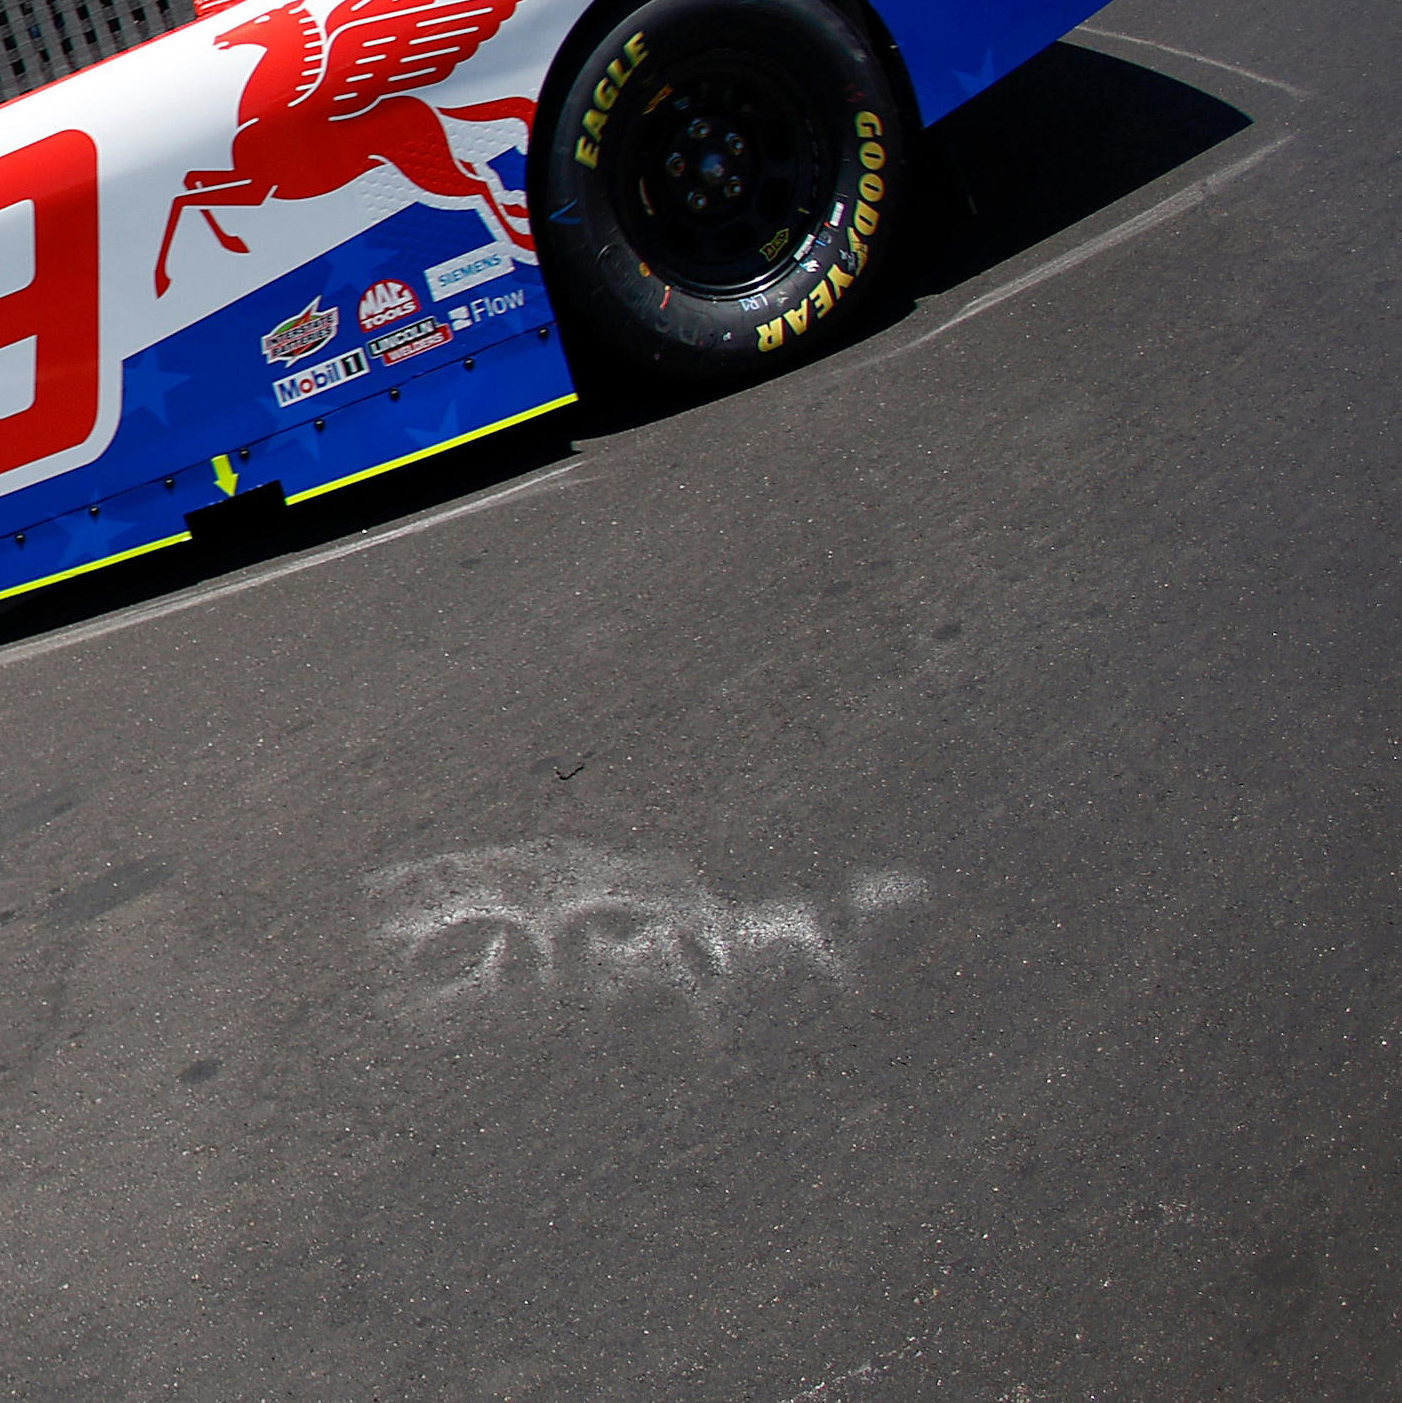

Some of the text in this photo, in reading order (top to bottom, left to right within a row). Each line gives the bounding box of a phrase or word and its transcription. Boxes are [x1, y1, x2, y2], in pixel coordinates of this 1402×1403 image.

[574, 31, 652, 170] EAGLE
[755, 111, 886, 352] GOODYEAR
[438, 254, 501, 287] SIEMENS
[359, 281, 414, 319] MAC
[363, 301, 417, 330] TOOLS
[470, 289, 525, 323] Flow
[267, 314, 334, 347] INTERSTATE
[272, 326, 333, 358] BATTERIES
[371, 318, 435, 354] LINCOLN
[388, 332, 444, 362] WELDERS
[279, 363, 341, 404] Mobil
